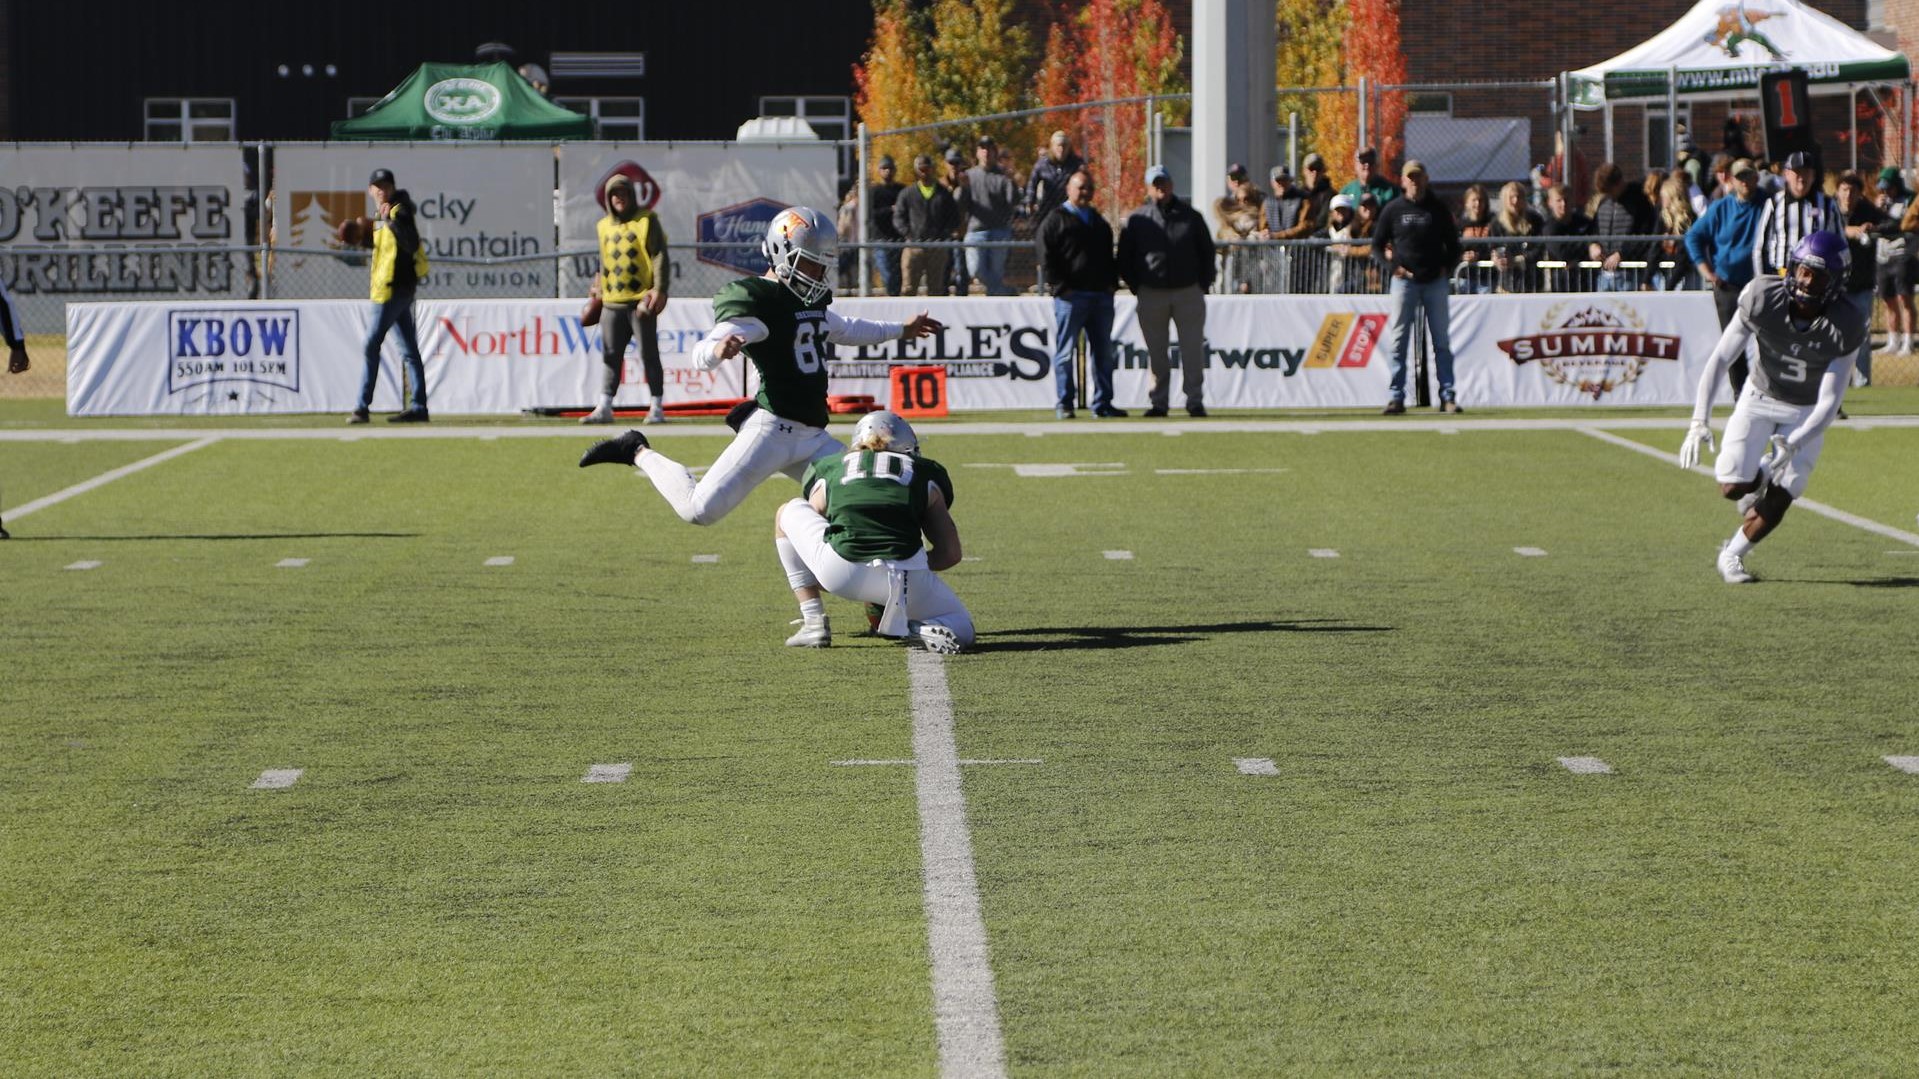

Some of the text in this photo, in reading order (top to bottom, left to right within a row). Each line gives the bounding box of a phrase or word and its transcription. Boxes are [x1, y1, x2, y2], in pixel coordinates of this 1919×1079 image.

[1777, 80, 1798, 127] 1
[417, 192, 476, 225] cky
[419, 231, 540, 257] ountain
[417, 272, 540, 286] DIT UNION
[176, 318, 290, 357] KBOW
[435, 316, 712, 357] NorthWer
[827, 324, 1050, 380] ELE'S
[1316, 319, 1343, 360] SUPER
[1349, 319, 1376, 362] STOPS
[1513, 334, 1674, 360] SUMMIT
[177, 361, 224, 378] 550AM
[619, 358, 717, 394] Eergy
[946, 364, 995, 377] PLIANCE
[1780, 354, 1807, 383] 3
[900, 373, 939, 409] 10
[840, 451, 914, 486] 10
